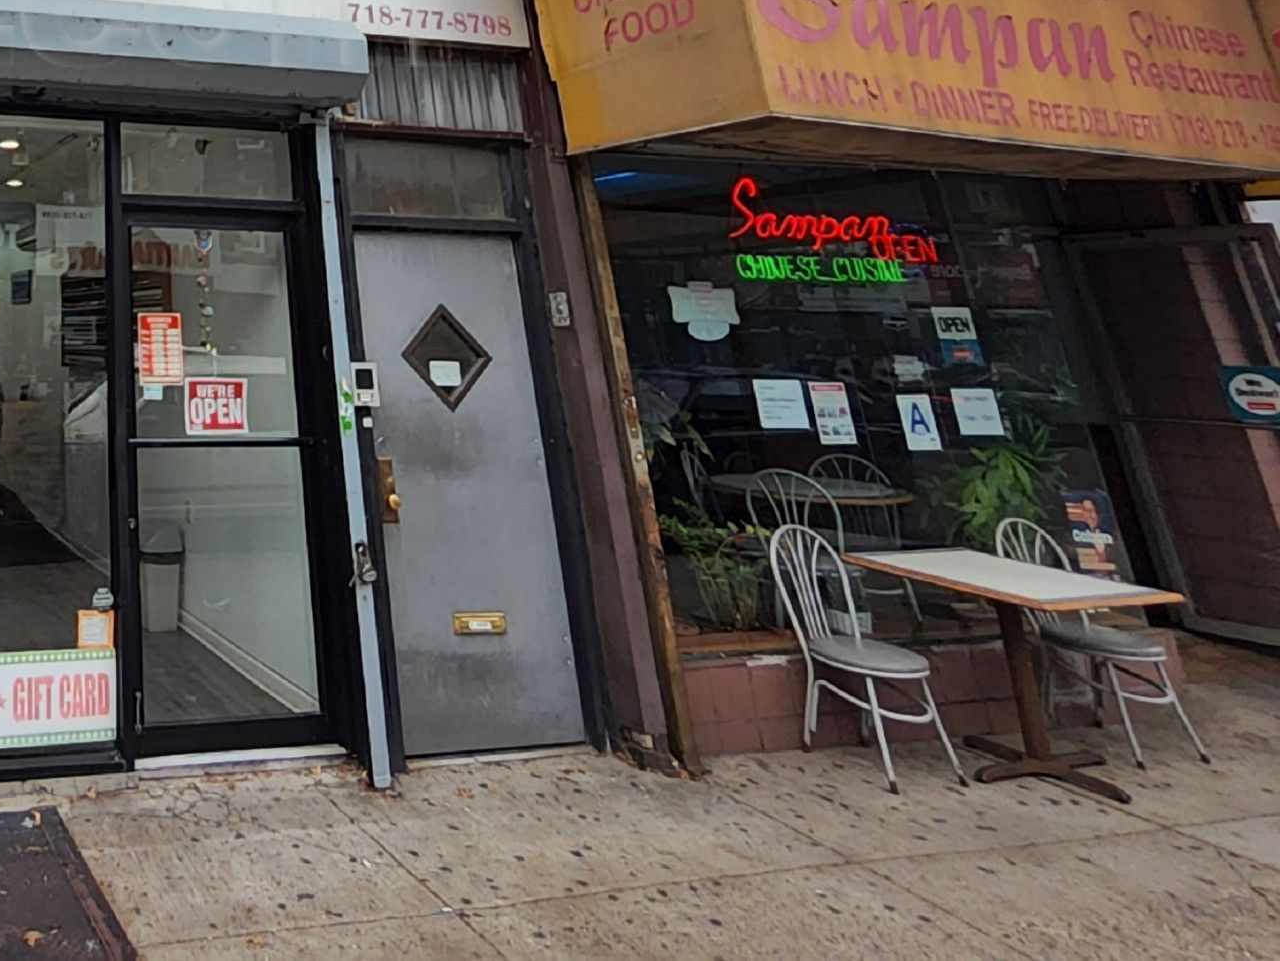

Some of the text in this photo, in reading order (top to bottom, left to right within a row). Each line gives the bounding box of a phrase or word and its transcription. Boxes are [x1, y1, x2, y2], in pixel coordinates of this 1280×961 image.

[347, 3, 512, 37] 718-777-8798
[1128, 9, 1245, 58] Chinese
[1122, 49, 1280, 103] Restaurant
[778, 65, 888, 113] LUNCH
[911, 80, 1020, 127] DINNER
[1028, 98, 1077, 133] FREE
[729, 176, 891, 251] Sampan
[735, 253, 822, 281] CHINESE
[831, 256, 908, 283] CUISINE
[936, 316, 971, 334] OPEN
[196, 383, 236, 399] WE'RE
[189, 397, 243, 425] OPEN
[910, 401, 931, 435] A
[11, 674, 55, 723] GIFT
[59, 672, 111, 719] CARD
